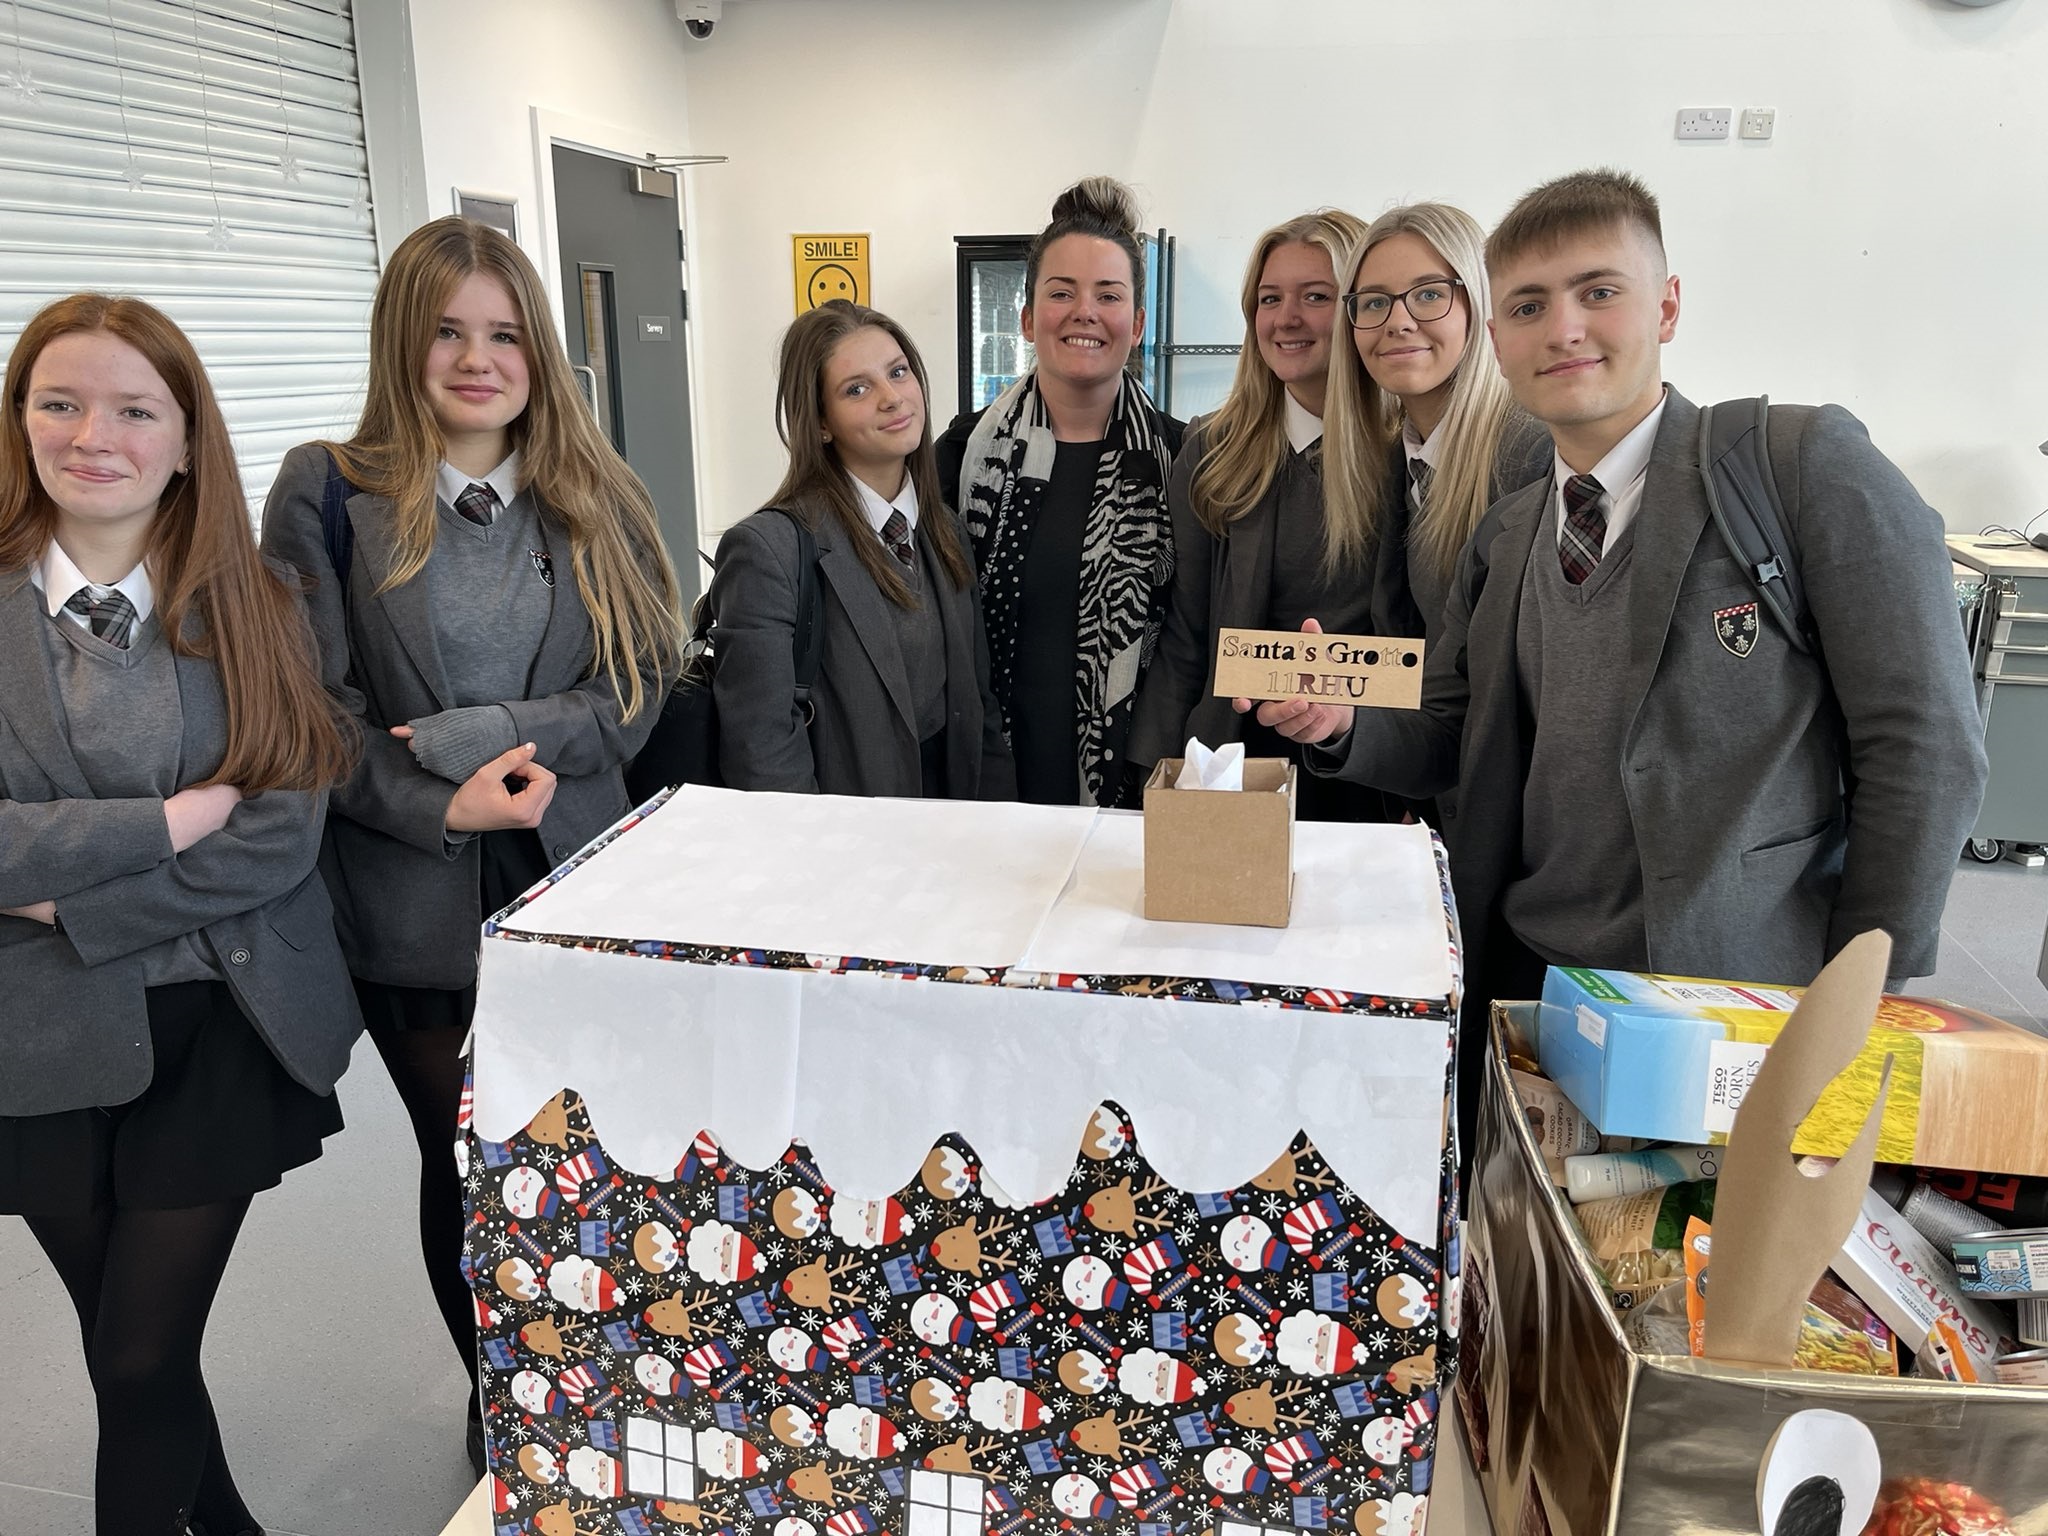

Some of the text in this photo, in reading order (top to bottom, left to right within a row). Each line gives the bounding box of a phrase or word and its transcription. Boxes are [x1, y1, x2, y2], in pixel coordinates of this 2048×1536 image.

[804, 241, 859, 257] SMILE!
[1222, 634, 1419, 669] Santa's Grotto
[1266, 669, 1369, 698] 11RHU
[1712, 1067, 1724, 1105] TESCO
[1727, 1065, 1744, 1110] CORN
[1555, 1126, 1563, 1160] COCONUT
[1564, 1116, 1574, 1149] ORGANIC
[1866, 1222, 1991, 1355] Creams
